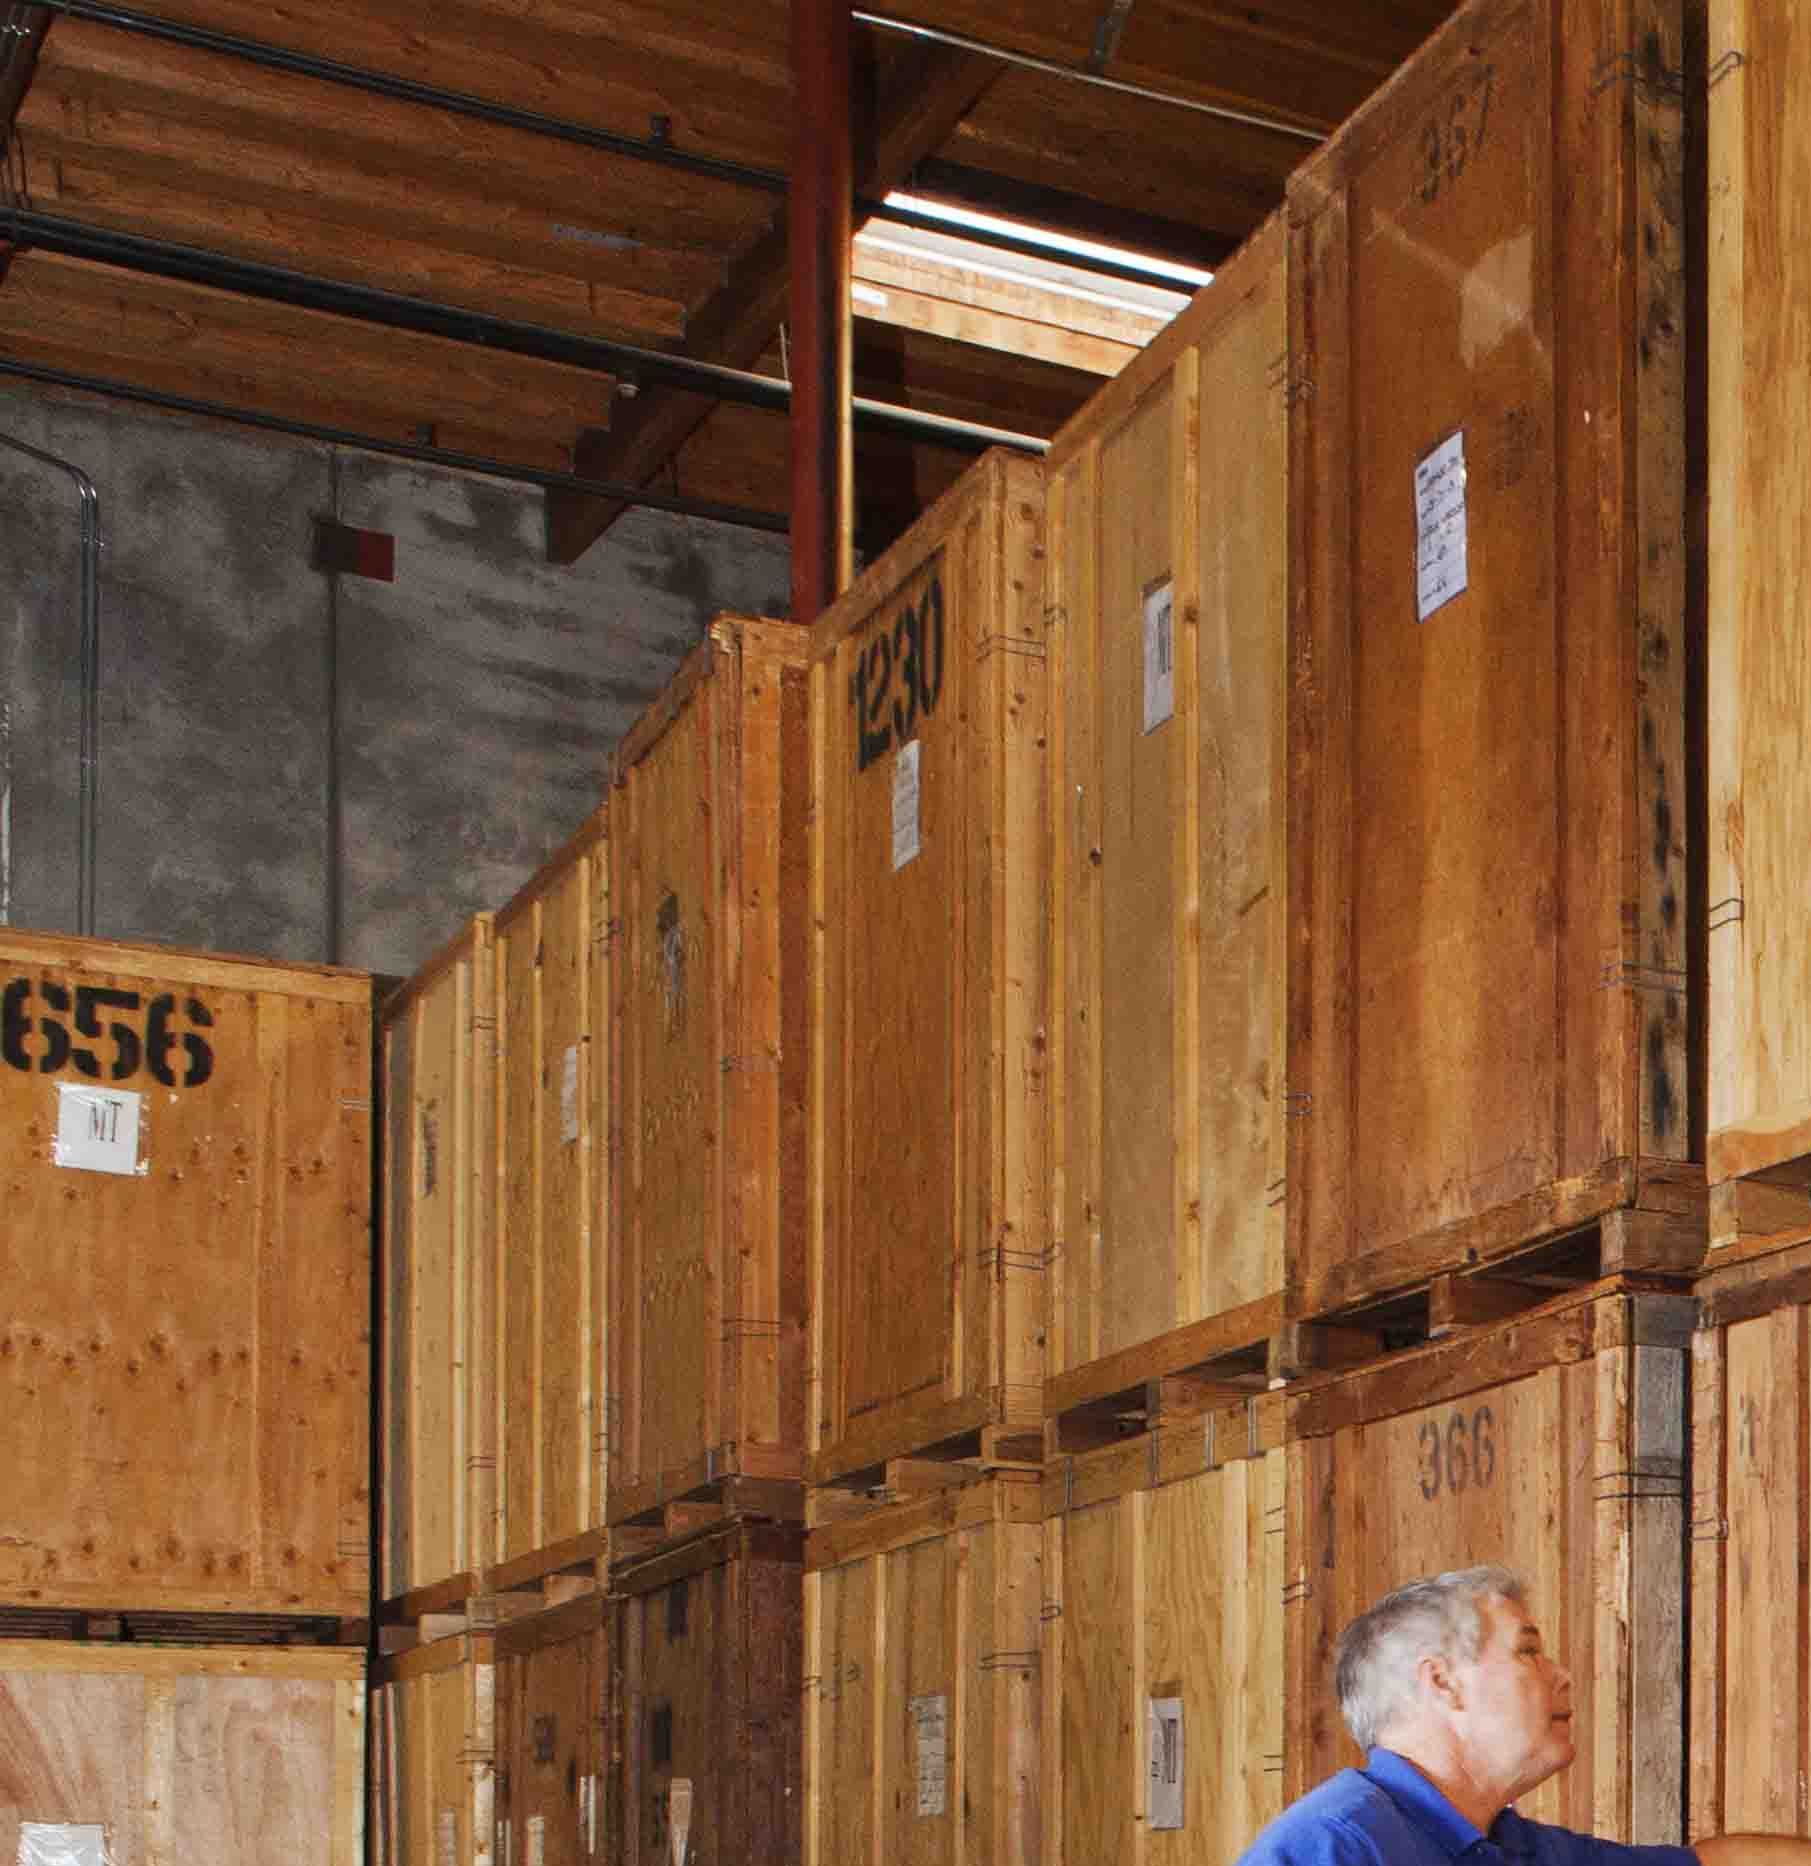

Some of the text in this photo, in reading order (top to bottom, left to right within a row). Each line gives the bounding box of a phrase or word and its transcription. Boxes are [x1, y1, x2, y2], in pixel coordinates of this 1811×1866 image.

[846, 576, 943, 770] 1230
[3, 977, 214, 1088] 656
[1417, 1407, 1495, 1500] 366
